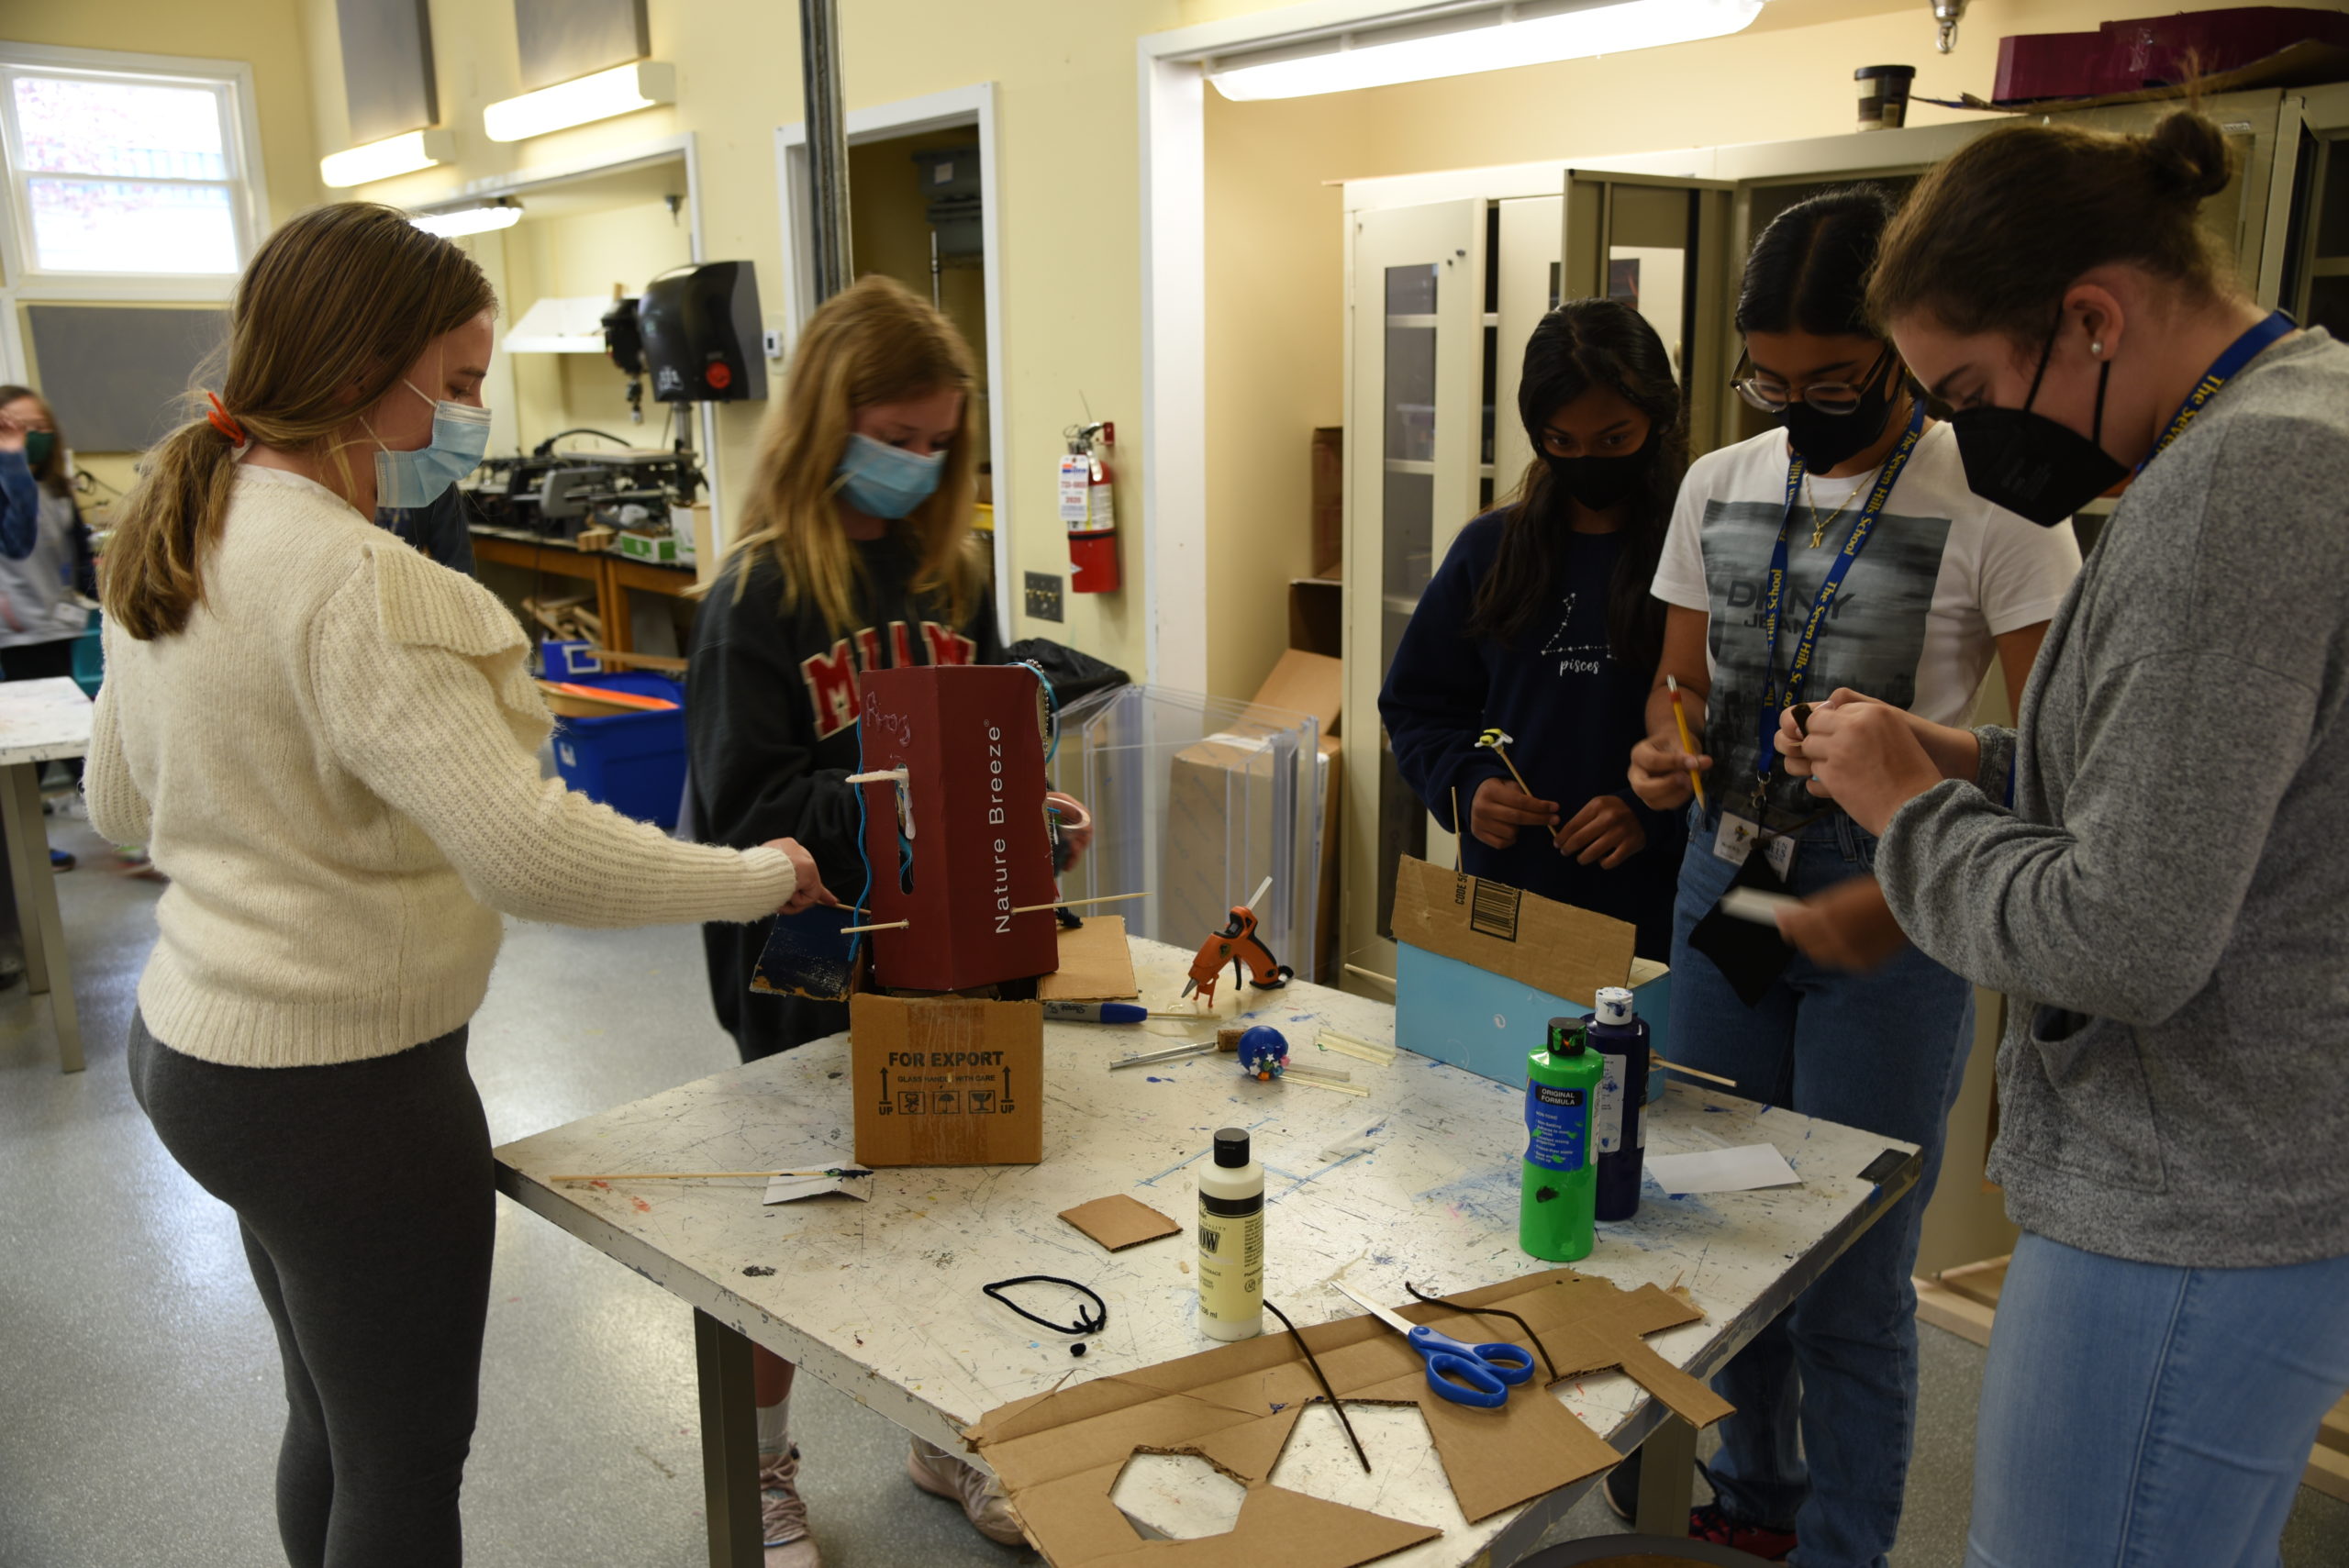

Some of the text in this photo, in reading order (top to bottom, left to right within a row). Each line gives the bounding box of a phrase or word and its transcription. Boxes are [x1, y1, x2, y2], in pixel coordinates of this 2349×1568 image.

[2191, 375, 2224, 405] The
[1843, 430, 1918, 556] The Seven Hills School
[1767, 569, 1783, 609] School
[1819, 581, 1838, 602] The
[1805, 605, 1825, 639] Seven
[1794, 642, 1812, 669] Hills
[1559, 659, 1600, 676] pisces
[988, 726, 1010, 934] Nature Breeze
[1454, 884, 1467, 906] CODE
[888, 1051, 1004, 1067] FOR EXPORT
[1542, 1088, 1575, 1098] ORIGINAL
[1542, 1095, 1575, 1106] FORMULA
[878, 1106, 893, 1116] UP
[1000, 1105, 1015, 1114] UP
